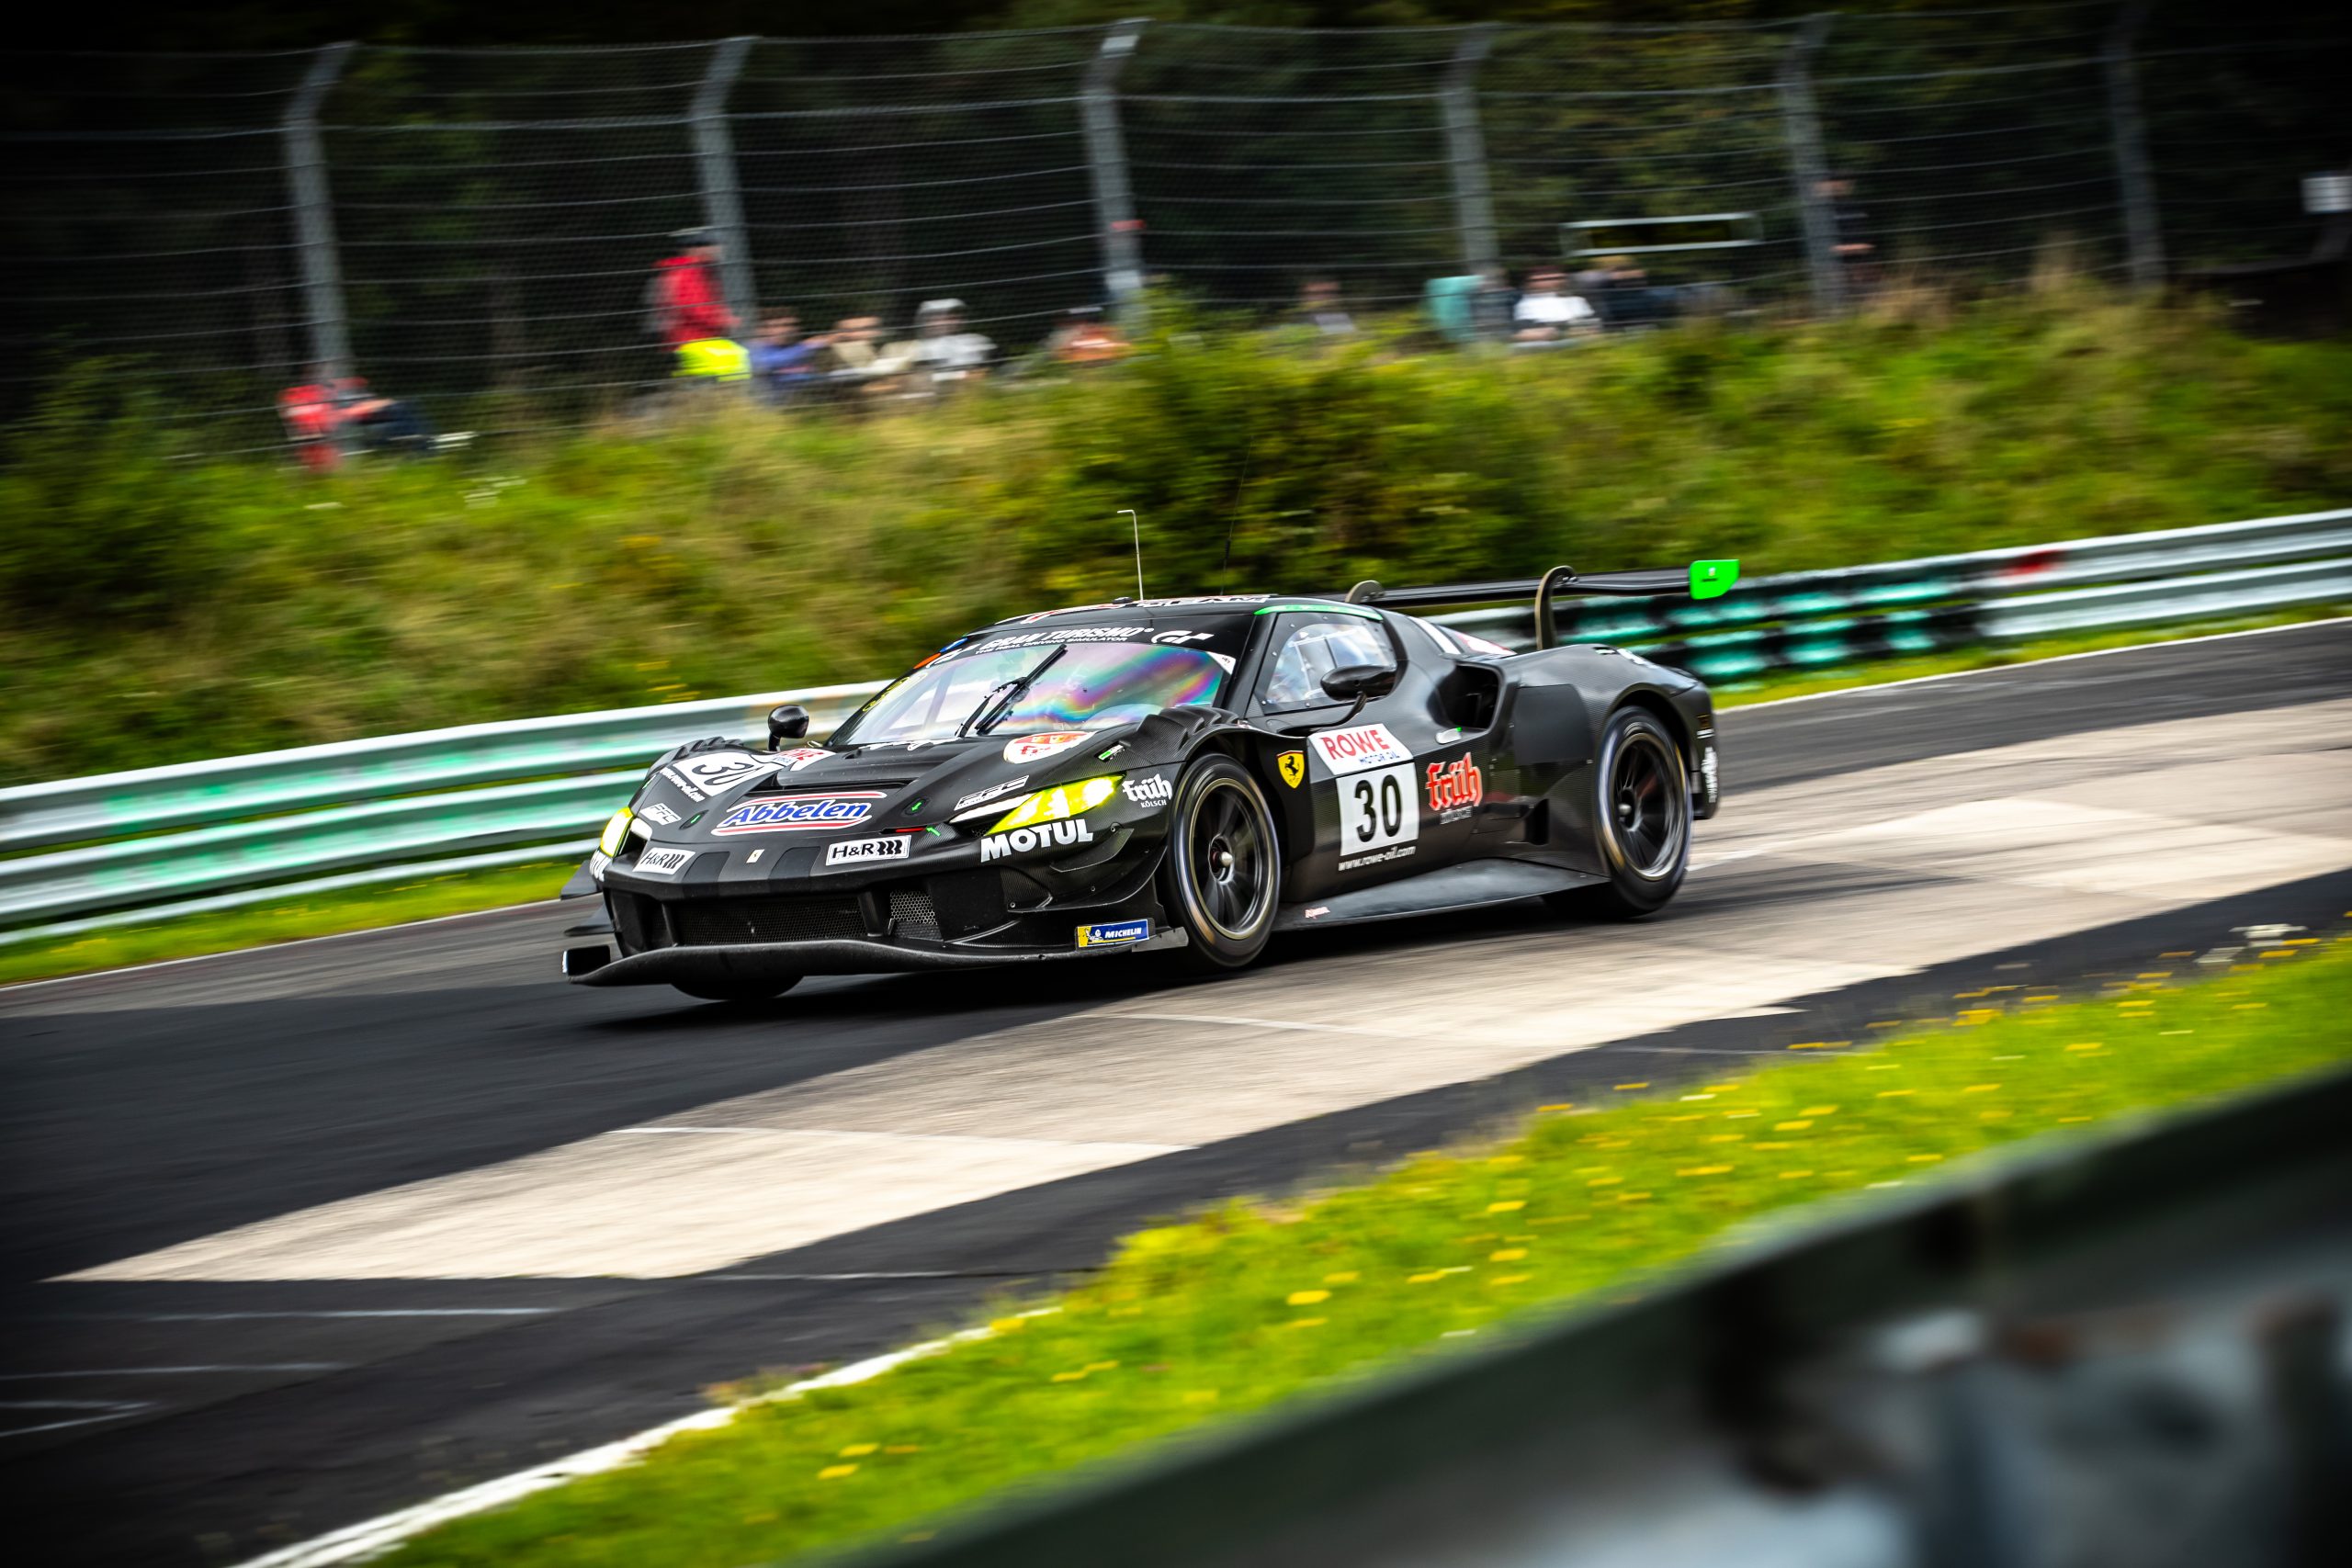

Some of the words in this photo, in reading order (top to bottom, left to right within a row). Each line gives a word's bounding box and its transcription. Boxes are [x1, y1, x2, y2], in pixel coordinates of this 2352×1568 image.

[1319, 729, 1391, 761] ROWE
[692, 761, 766, 786] 30
[721, 799, 871, 827] Abbelen
[1140, 798, 1168, 808] KÖLSCH
[1353, 773, 1402, 843] 30
[831, 842, 875, 859] H&R
[980, 818, 1093, 863] MOTUL
[1104, 927, 1142, 938] MICHELIN
